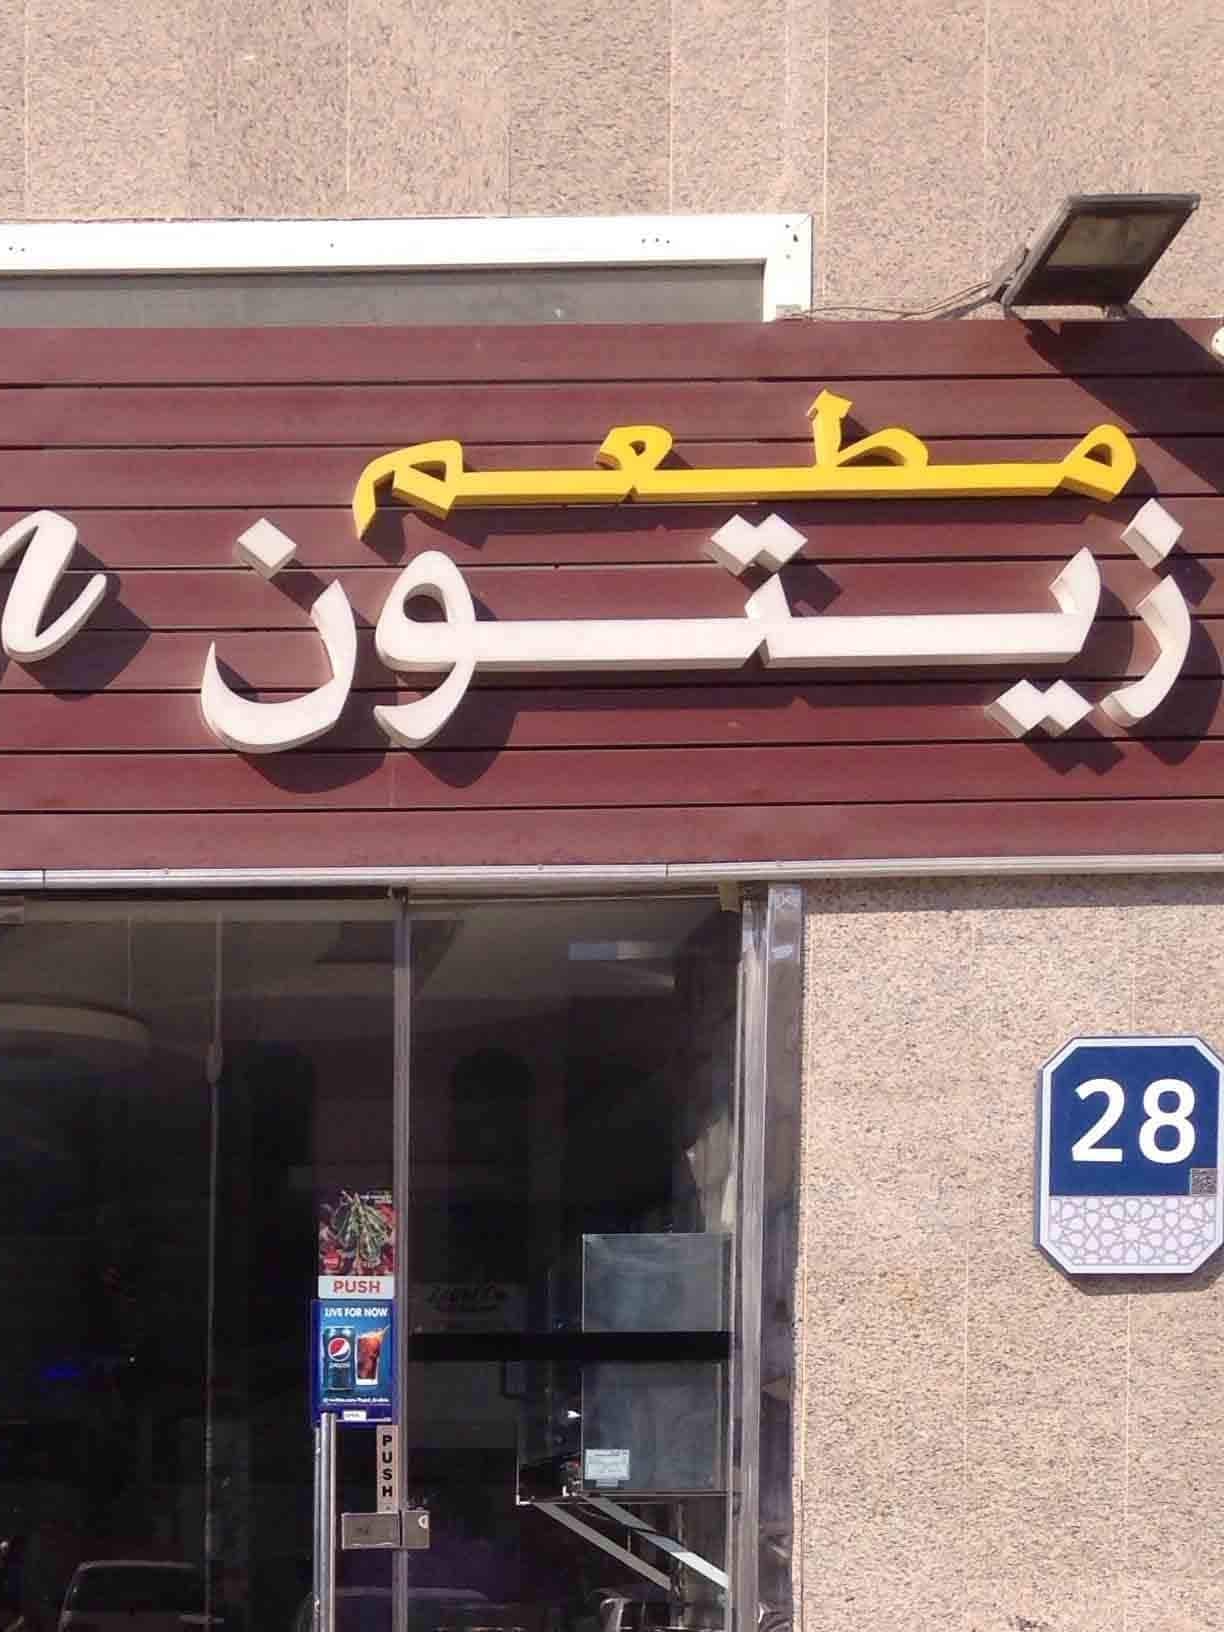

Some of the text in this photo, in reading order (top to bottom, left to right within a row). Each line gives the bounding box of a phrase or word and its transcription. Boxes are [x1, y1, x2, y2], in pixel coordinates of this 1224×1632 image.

[353, 389, 1137, 540] مطعم
[200, 499, 1193, 752] زيتون
[1071, 1078, 1196, 1164] 28
[324, 1307, 389, 1318] LIVE FOR NOW
[333, 1280, 381, 1294] PUSH
[382, 1434, 393, 1498] PUSH
